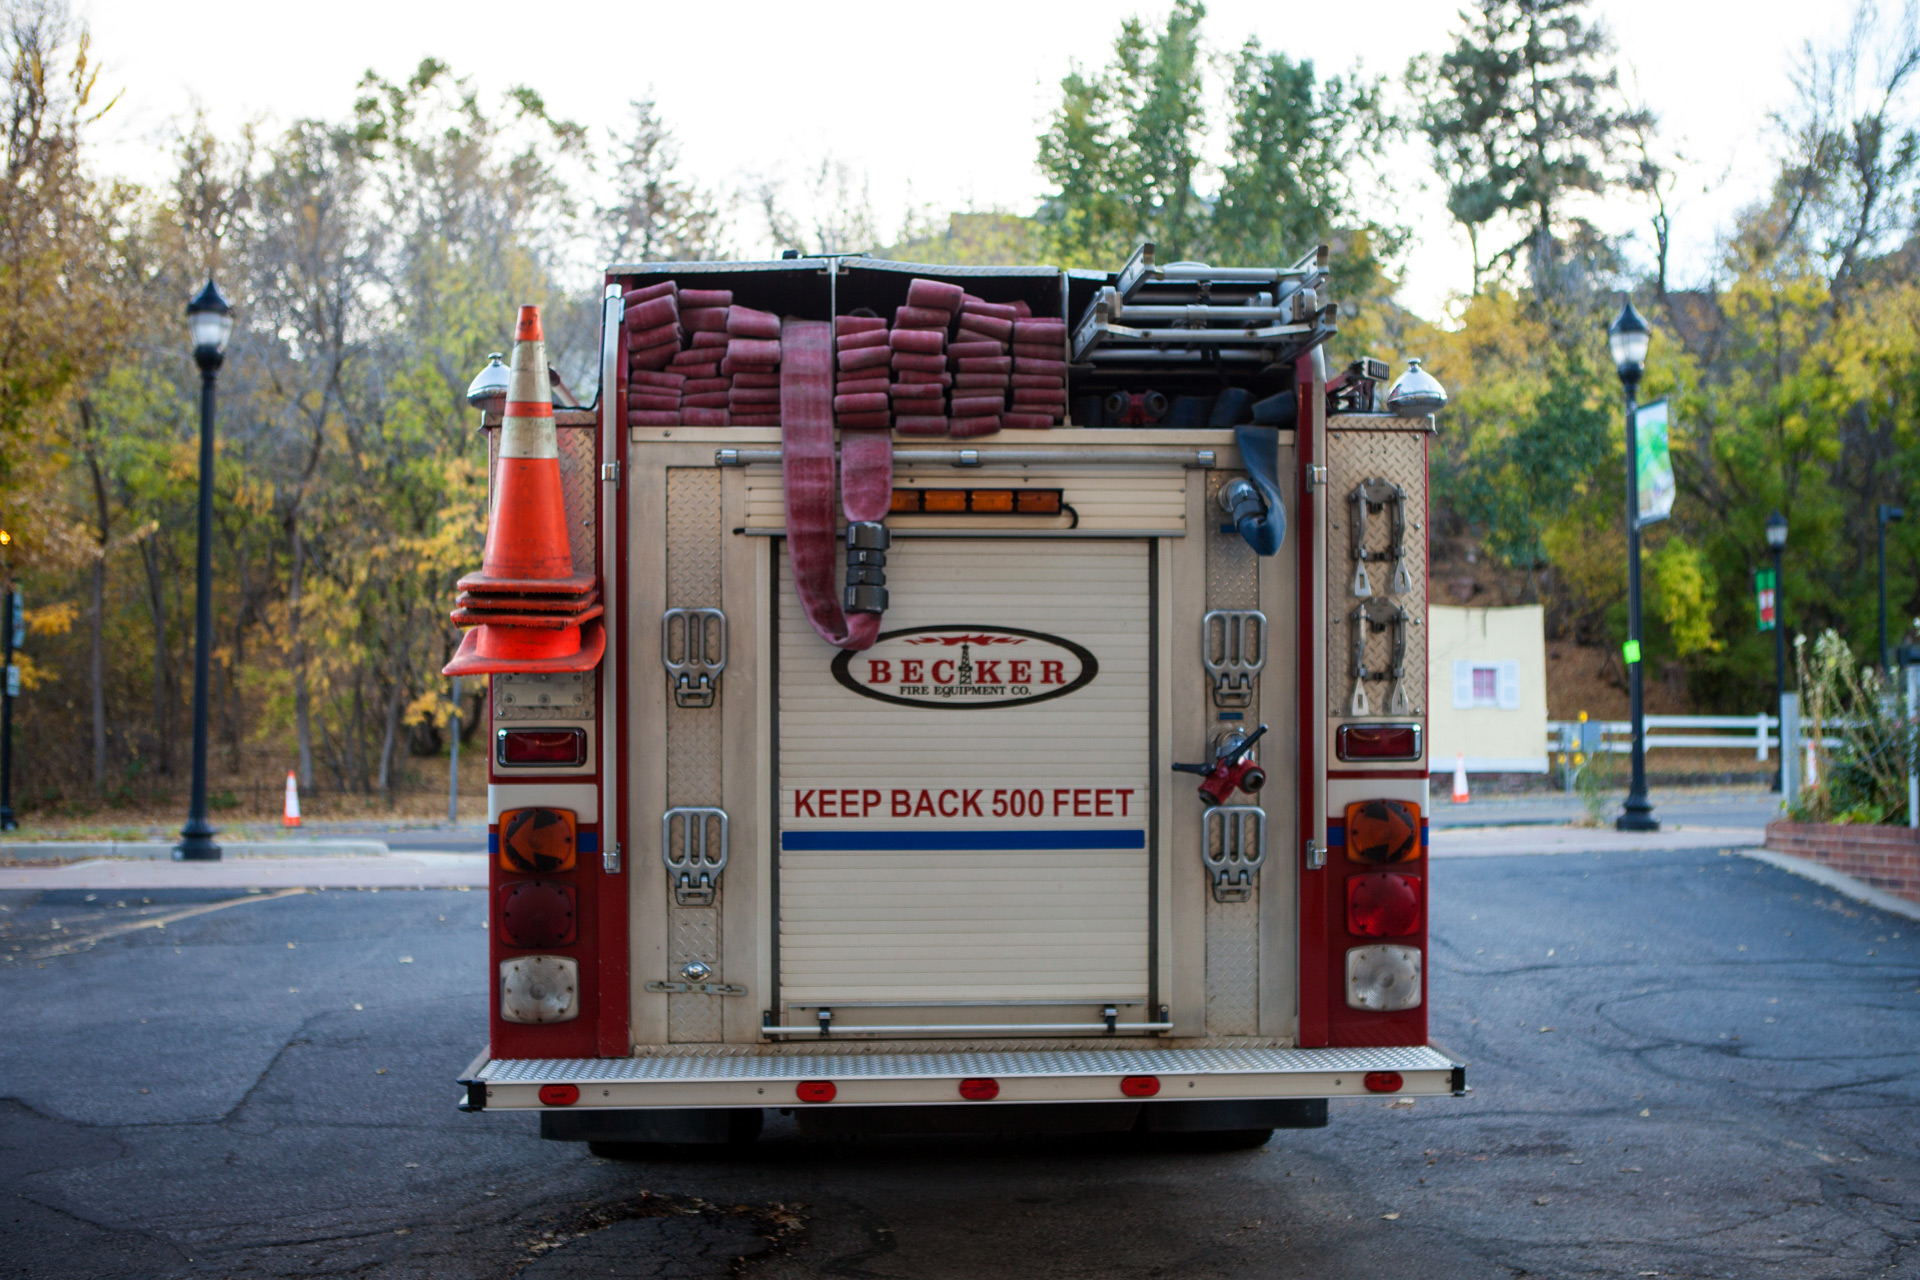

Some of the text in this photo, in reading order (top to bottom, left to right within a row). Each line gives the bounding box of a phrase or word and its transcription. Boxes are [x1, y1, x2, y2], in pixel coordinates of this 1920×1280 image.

[867, 659, 1067, 685] BECKER
[900, 685, 1032, 698] FIRE EQUIPMENT CO.
[794, 788, 1135, 818] KEEP BACK 500 FEET
